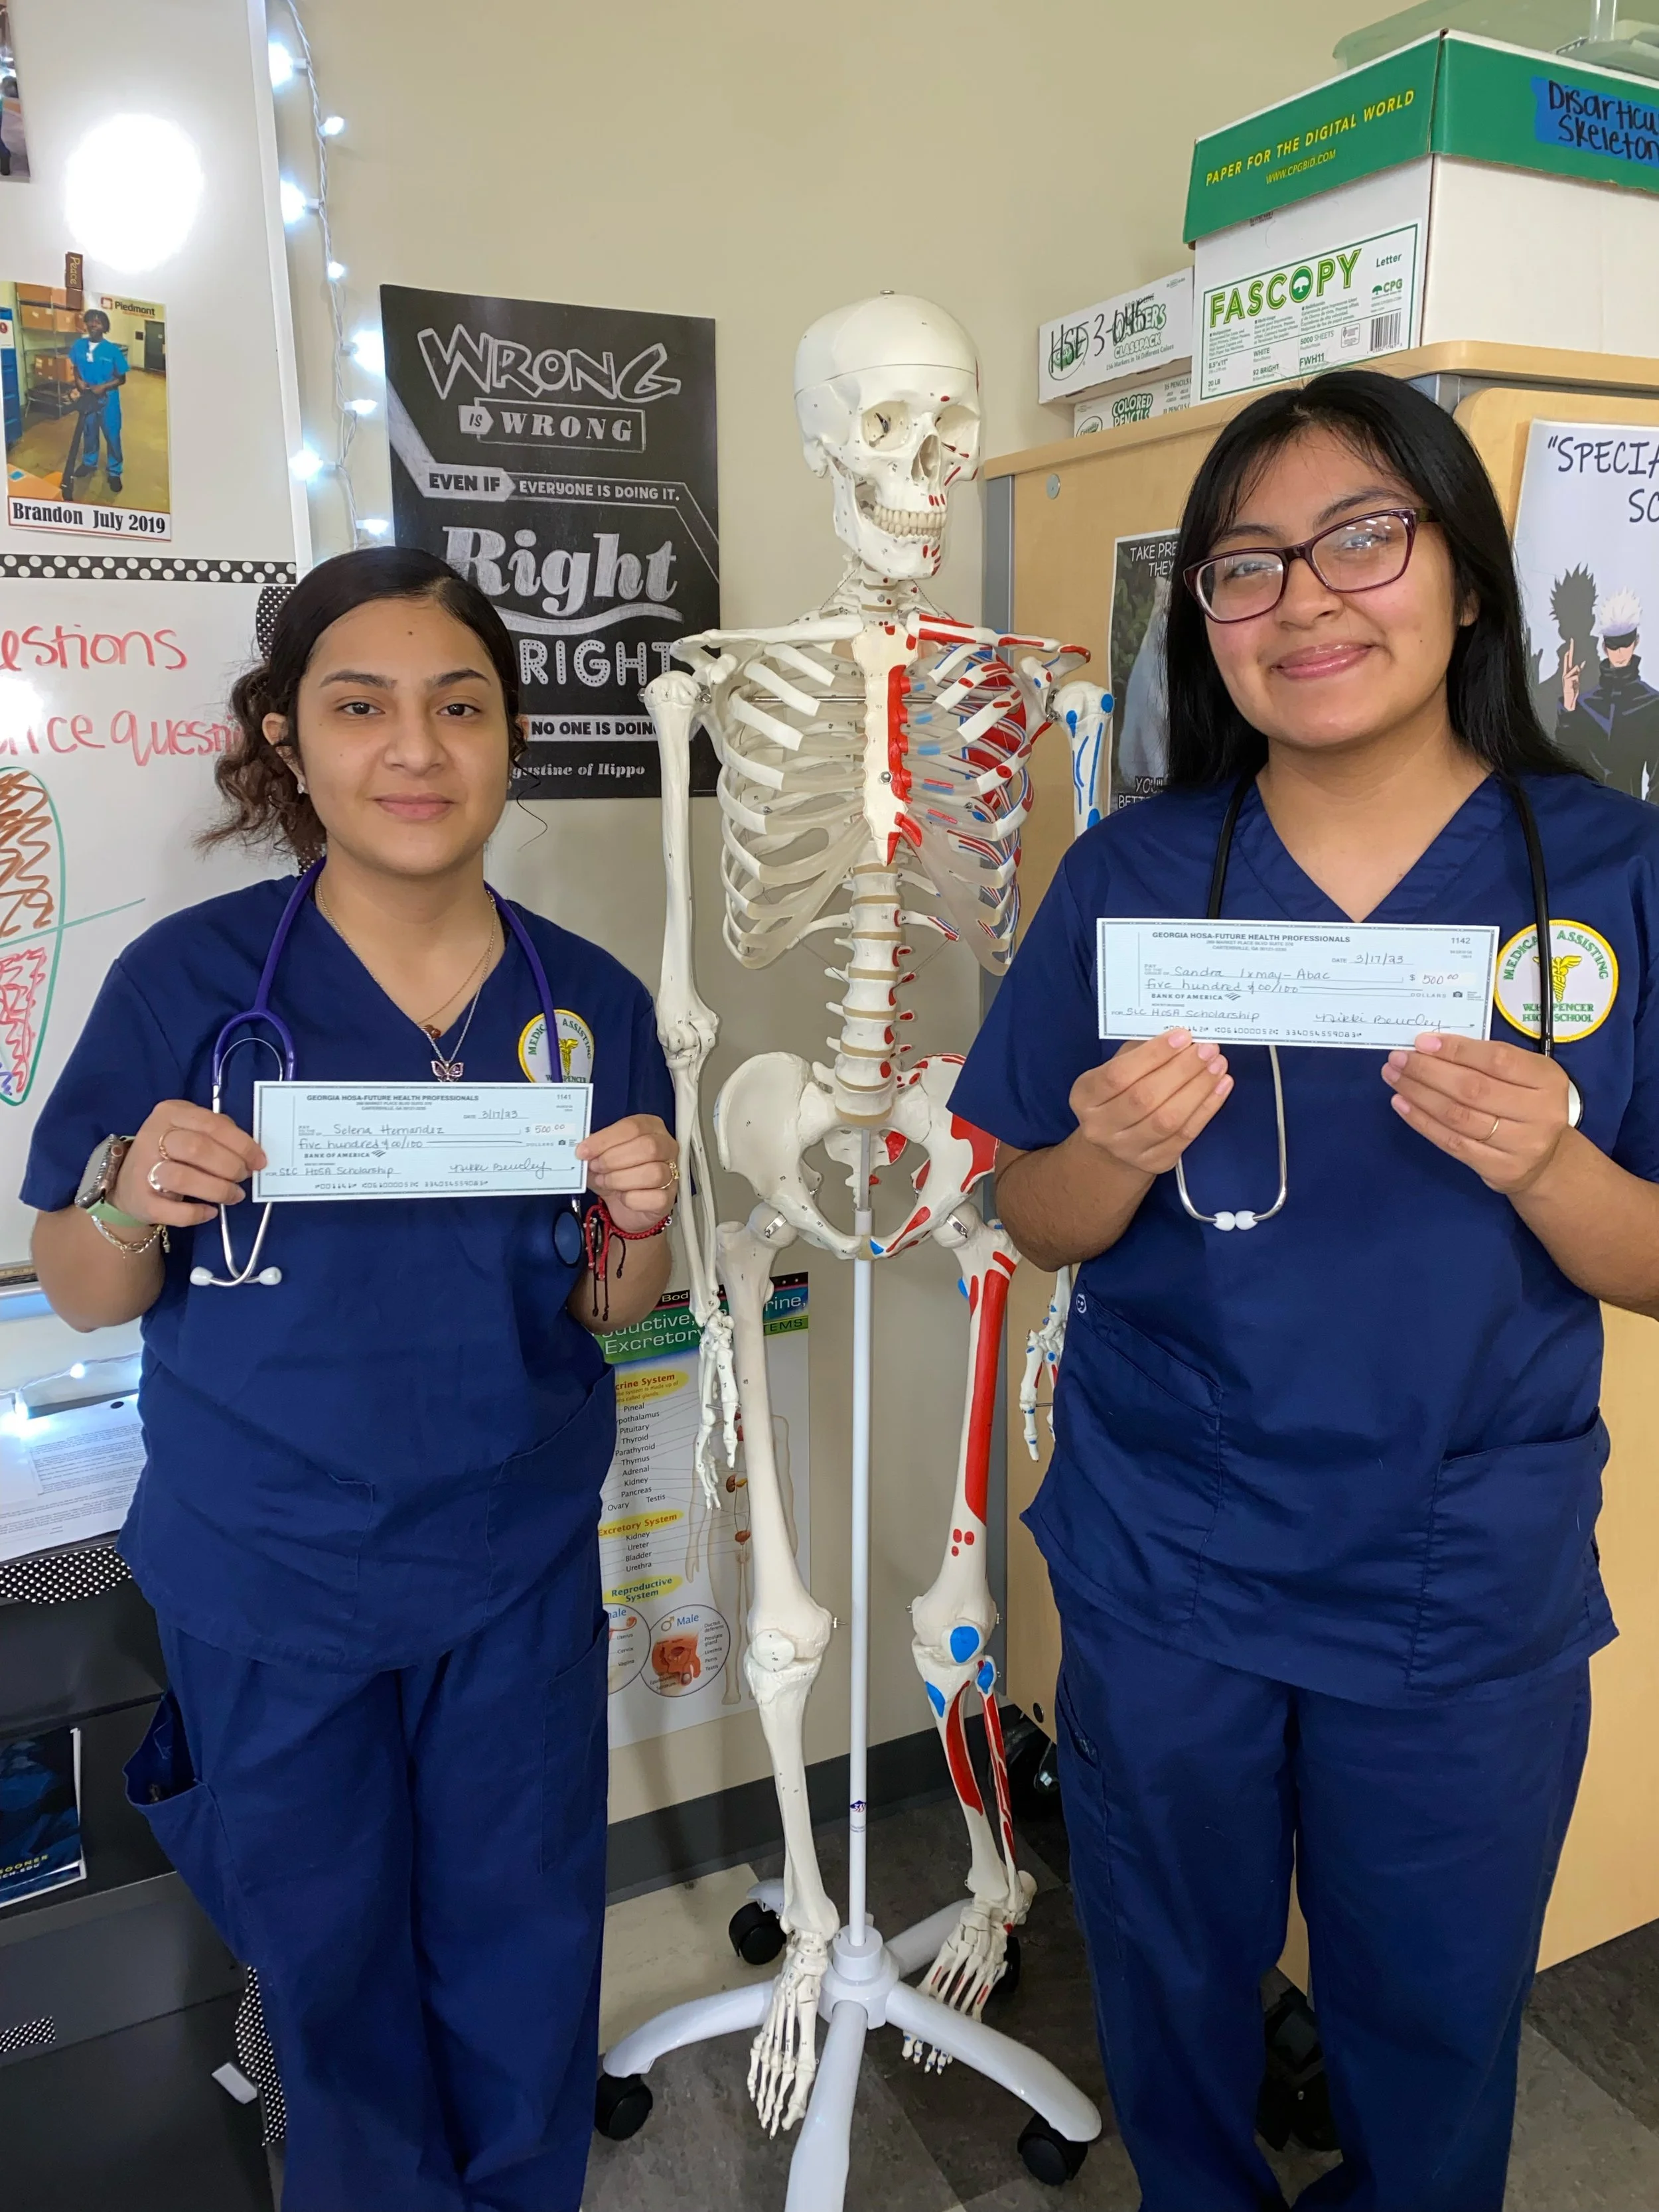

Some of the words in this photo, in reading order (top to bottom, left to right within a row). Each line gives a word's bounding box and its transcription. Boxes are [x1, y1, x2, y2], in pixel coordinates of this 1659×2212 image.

[1549, 80, 1659, 135] Disarticu
[1206, 161, 1242, 186] PAPER
[1247, 150, 1271, 170] FOR
[1276, 137, 1300, 159] THE
[1305, 115, 1356, 146] DIGITAL
[1363, 90, 1415, 123] WORLD
[1558, 114, 1659, 160] Skeleton
[1265, 149, 1336, 184] WWW.CPGBID.COM
[1376, 254, 1402, 267] Letter
[70, 256, 80, 285] Peace
[1209, 248, 1361, 328] FASCOPY
[1383, 278, 1403, 293] CPG
[115, 301, 155, 315] Piedmont
[1301, 336, 1313, 344] 5000
[1314, 330, 1334, 342] SHEETS
[1050, 322, 1089, 373] HSE
[1114, 332, 1161, 359] CLASSPACK
[1253, 347, 1270, 357] WHITE
[417, 323, 682, 403] WRONG
[1114, 358, 1130, 368] Markers
[1141, 348, 1159, 360] Different
[1160, 344, 1174, 353] Colors
[1299, 353, 1325, 367] FWH11
[1260, 364, 1279, 374] BRIGHT
[1171, 378, 1189, 388] PENCILS
[1112, 393, 1153, 417] COLORED
[469, 413, 482, 427] IS
[500, 411, 632, 442] WRONG
[429, 473, 478, 491] EVEN
[483, 475, 501, 492] IF
[519, 480, 594, 497] EVERYONE
[597, 483, 611, 498] IS
[614, 485, 659, 500] DOING
[663, 488, 680, 501] IT.
[13, 502, 83, 525] Brandon
[93, 510, 123, 531] July
[129, 515, 165, 534] 2019
[1130, 544, 1156, 562] TAKE
[1158, 541, 1178, 558] PRE
[443, 526, 678, 616] Right
[1149, 559, 1175, 577] THEY
[519, 639, 674, 687] RIGHT
[531, 721, 555, 735] NO
[559, 721, 591, 735] ONE
[596, 721, 611, 735] IS
[614, 721, 657, 735] DOIN
[578, 763, 594, 776] of
[598, 763, 645, 777] Hippo
[1282, 934, 1350, 943] PROFESSIONALS
[1356, 951, 1404, 966] 3/17/23
[1503, 935, 1539, 980] MEDICA
[1557, 930, 1609, 980] ASSISTING
[1175, 966, 1222, 977] Sandra
[1145, 978, 1172, 990] five
[1182, 978, 1242, 992] hundred
[1186, 1009, 1260, 1022] Scholarship
[1554, 1013, 1593, 1022] SCHOOL
[528, 1023, 547, 1056] MEDIC
[562, 1018, 591, 1060] ASSISTING
[334, 1124, 372, 1135] Selena
[298, 1138, 320, 1149] five
[327, 1138, 378, 1149] hundred
[336, 1167, 394, 1178] Scholarship
[662, 1292, 689, 1303] Bod
[765, 1296, 806, 1312] rine,
[605, 1328, 703, 1355] Excretory
[615, 1380, 638, 1390] crine
[641, 1374, 675, 1386] System
[624, 1402, 644, 1412] Pineal
[619, 1424, 650, 1435] Pituitary
[621, 1434, 649, 1445] Thyroid
[615, 1443, 656, 1457] Parathyroid
[621, 1455, 650, 1467] Thymus
[622, 1465, 650, 1476] Adrenal
[624, 1476, 649, 1487] Kidney
[620, 1486, 652, 1498] Pancreas
[646, 1493, 666, 1503] Testis
[607, 1501, 630, 1512] Ovary
[598, 1521, 641, 1537] Excretory
[644, 1513, 678, 1527] System
[626, 1530, 650, 1542] Kidney
[627, 1541, 649, 1551] Ureter
[625, 1551, 652, 1562] Bladder
[626, 1562, 652, 1572] Urethra
[611, 1576, 673, 1597] Reproductive
[625, 1589, 659, 1603] System
[676, 1613, 699, 1627] Male
